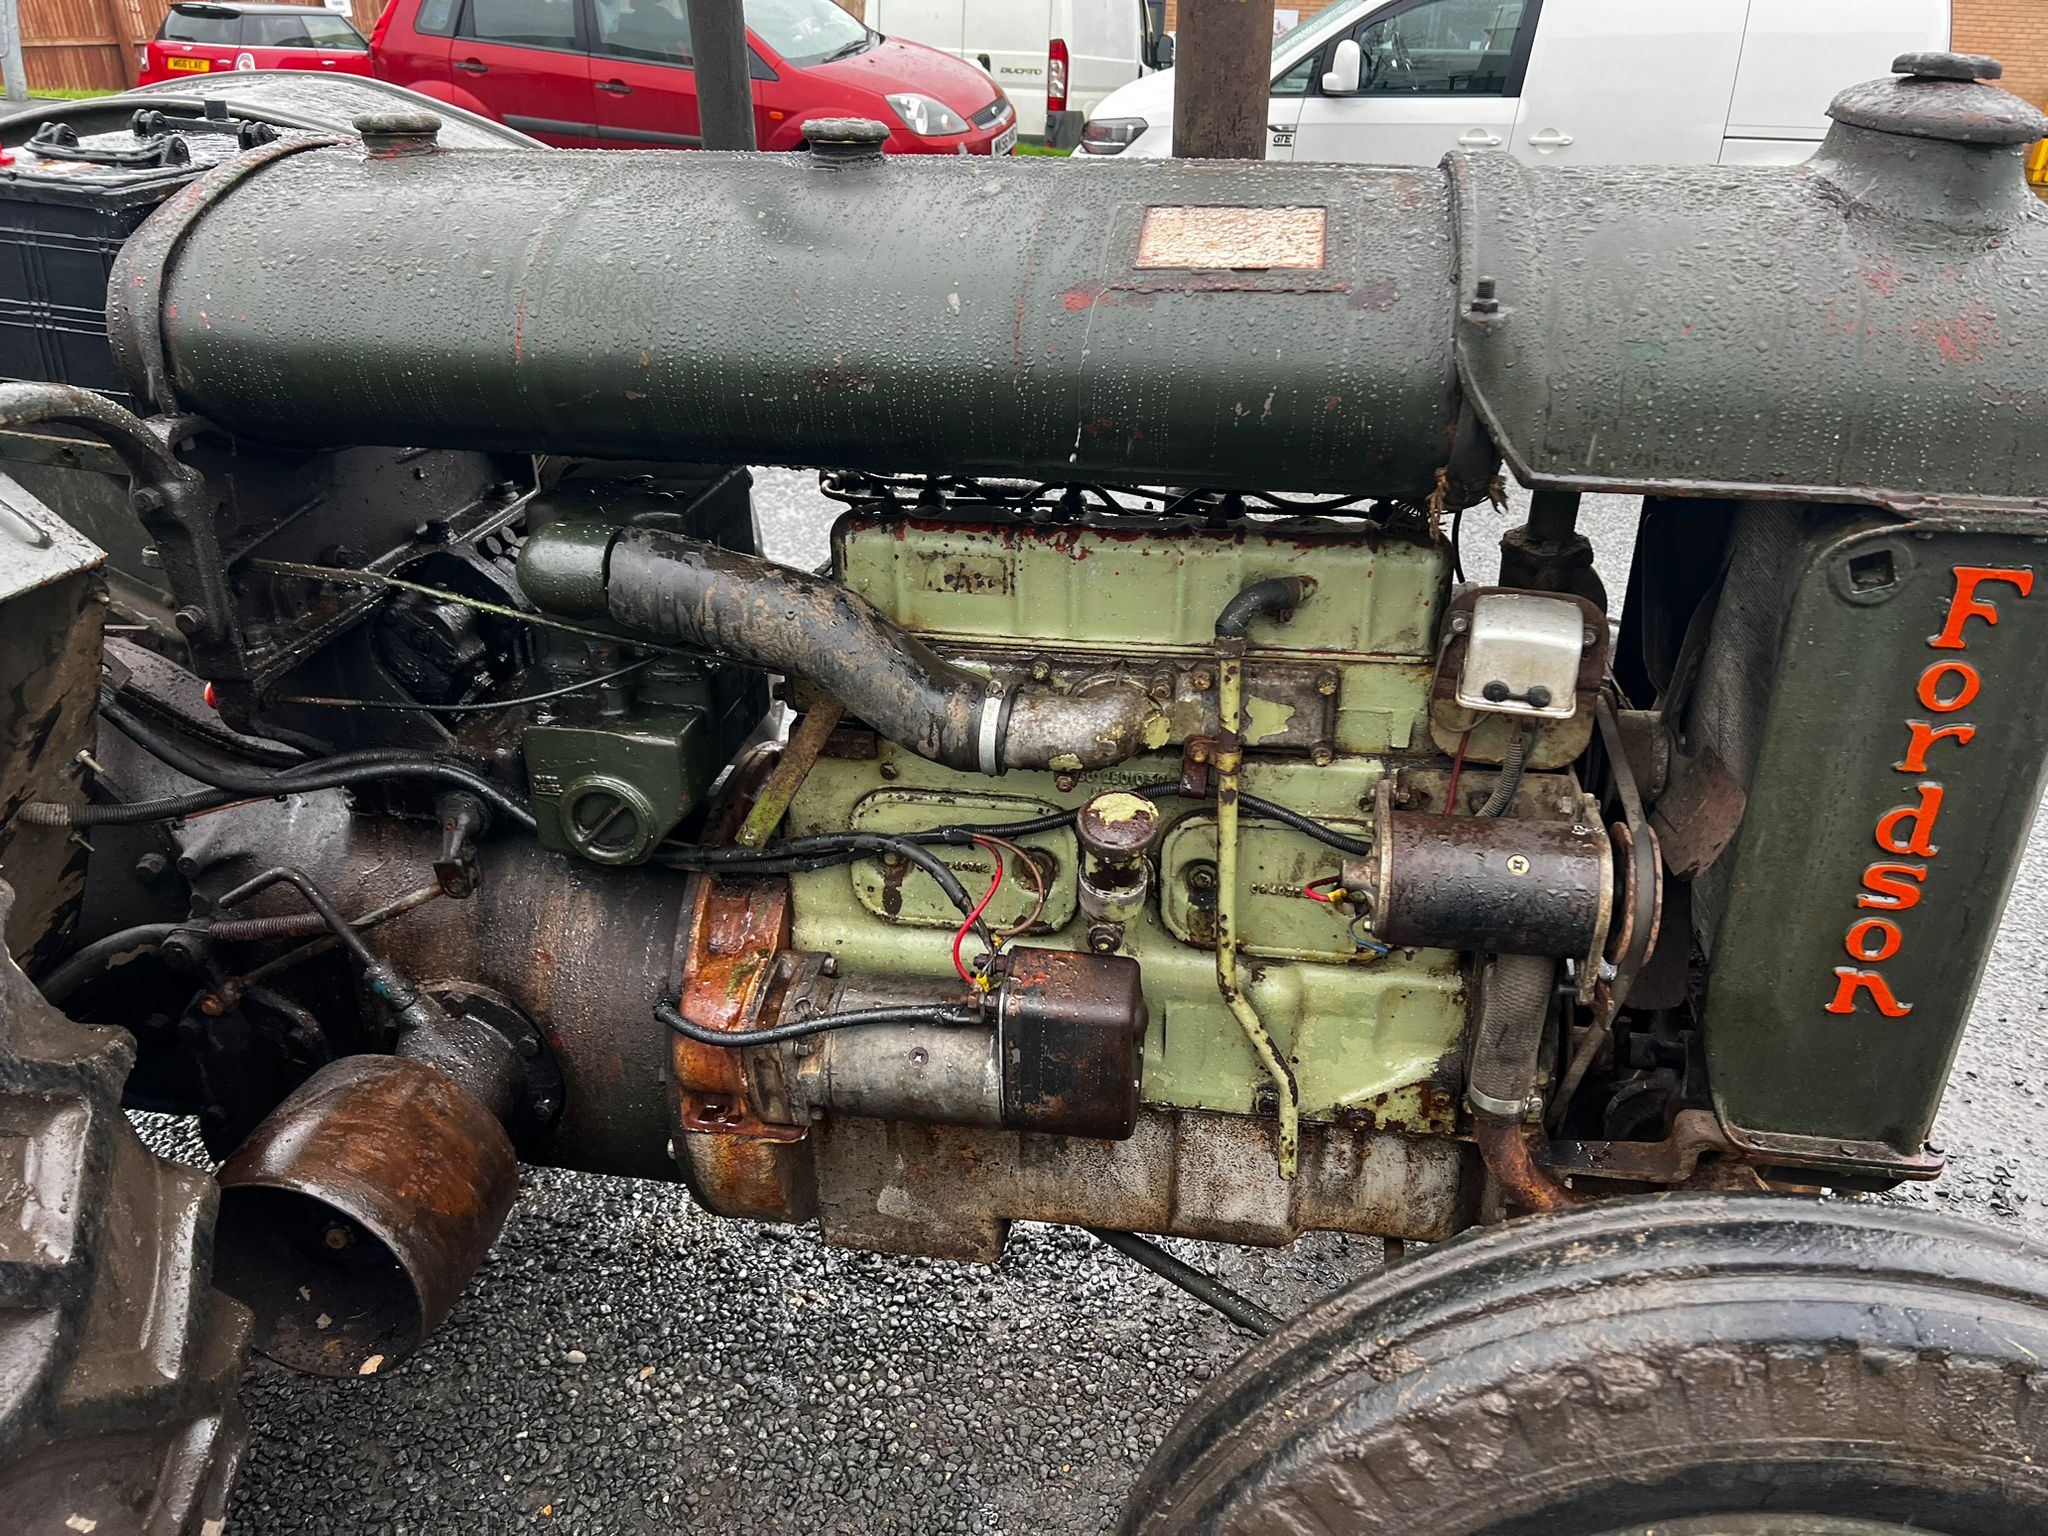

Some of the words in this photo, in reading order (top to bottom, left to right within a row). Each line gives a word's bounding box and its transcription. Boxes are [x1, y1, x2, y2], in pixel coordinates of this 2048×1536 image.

[1000, 67, 1041, 75] DUCATO
[1273, 134, 1292, 143] GTE
[1826, 565, 2033, 1017] Fordson
